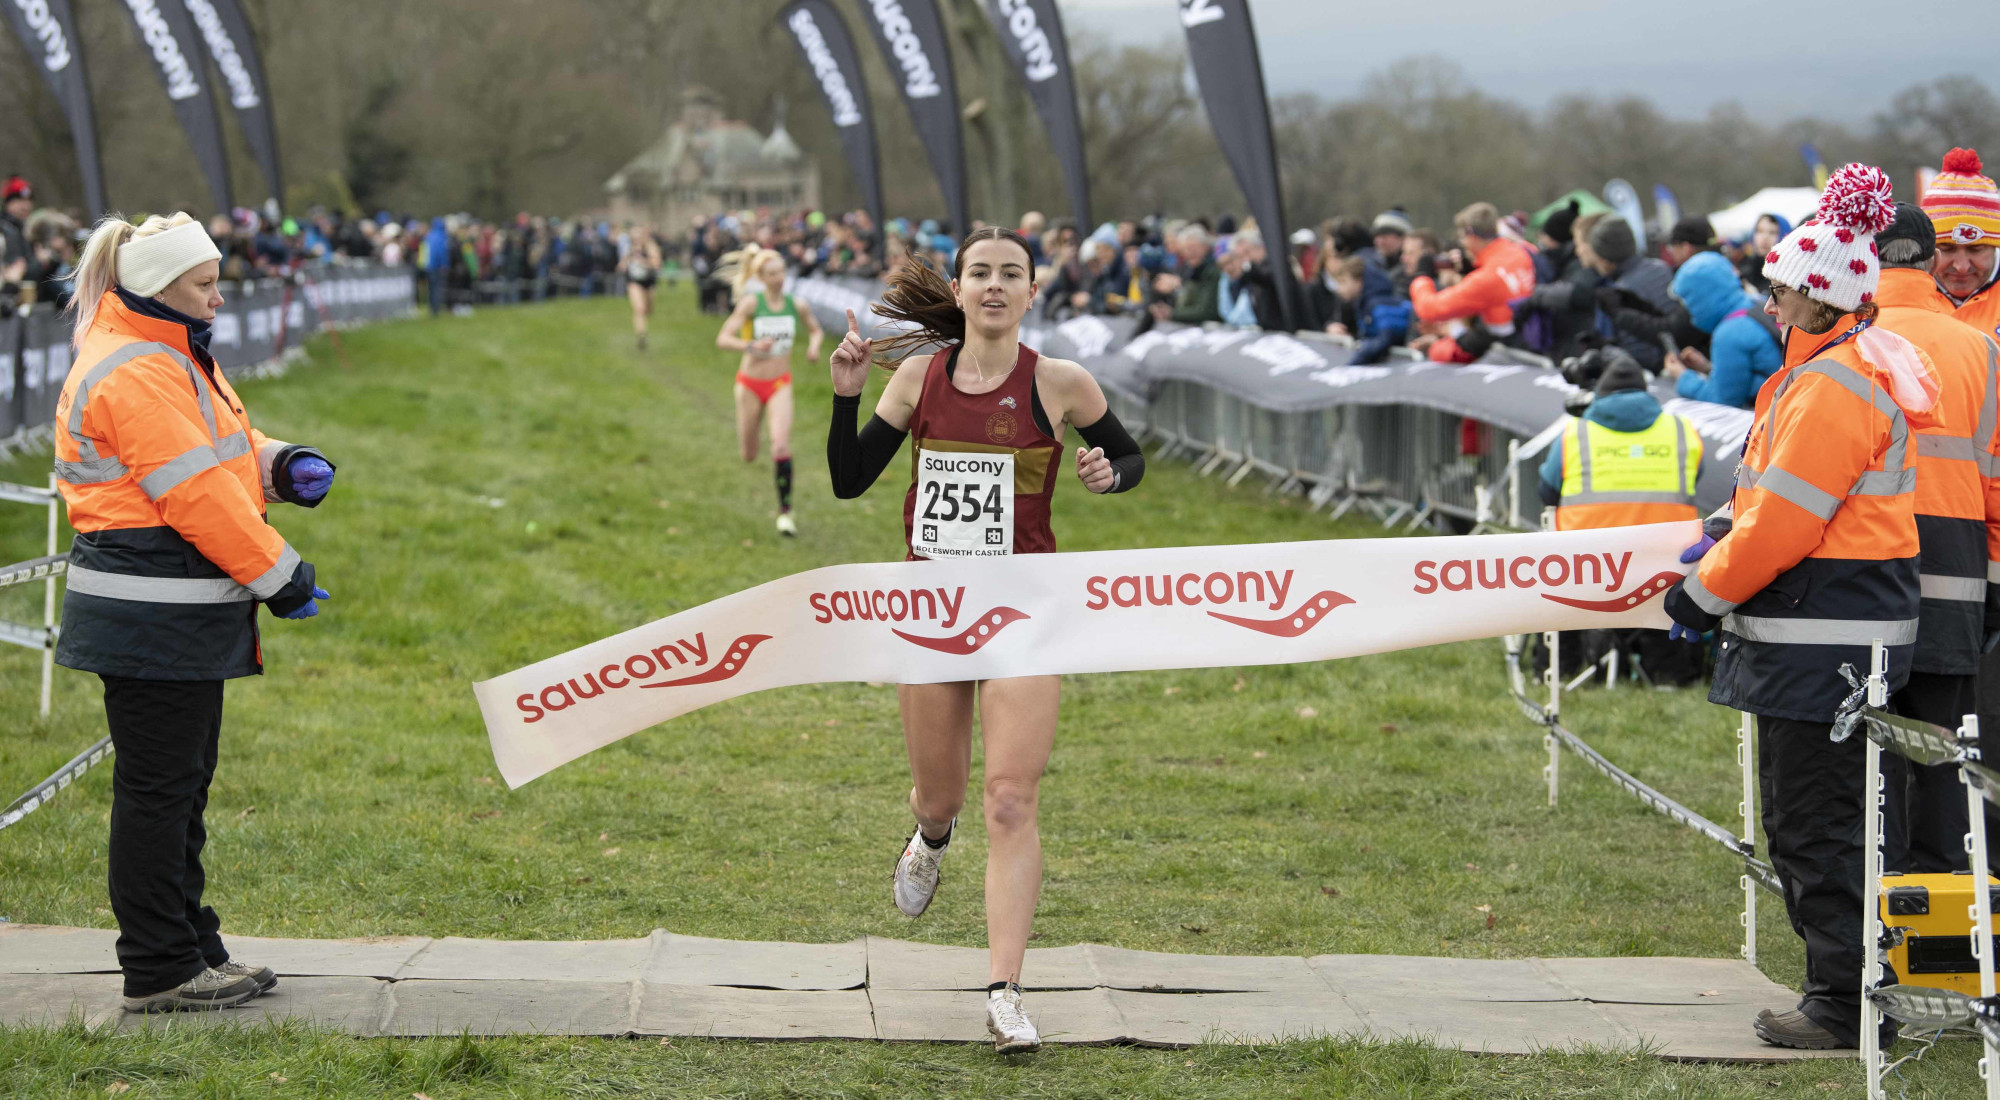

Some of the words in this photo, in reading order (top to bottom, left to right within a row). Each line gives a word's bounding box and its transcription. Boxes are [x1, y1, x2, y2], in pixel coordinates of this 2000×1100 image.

[868, 0, 941, 98] ucony
[925, 456, 1005, 476] saucony
[921, 480, 1004, 523] 2554
[1086, 569, 1294, 611] saucony
[1413, 551, 1633, 595] saucony
[809, 586, 966, 629] saucony
[515, 631, 710, 724] saucony
